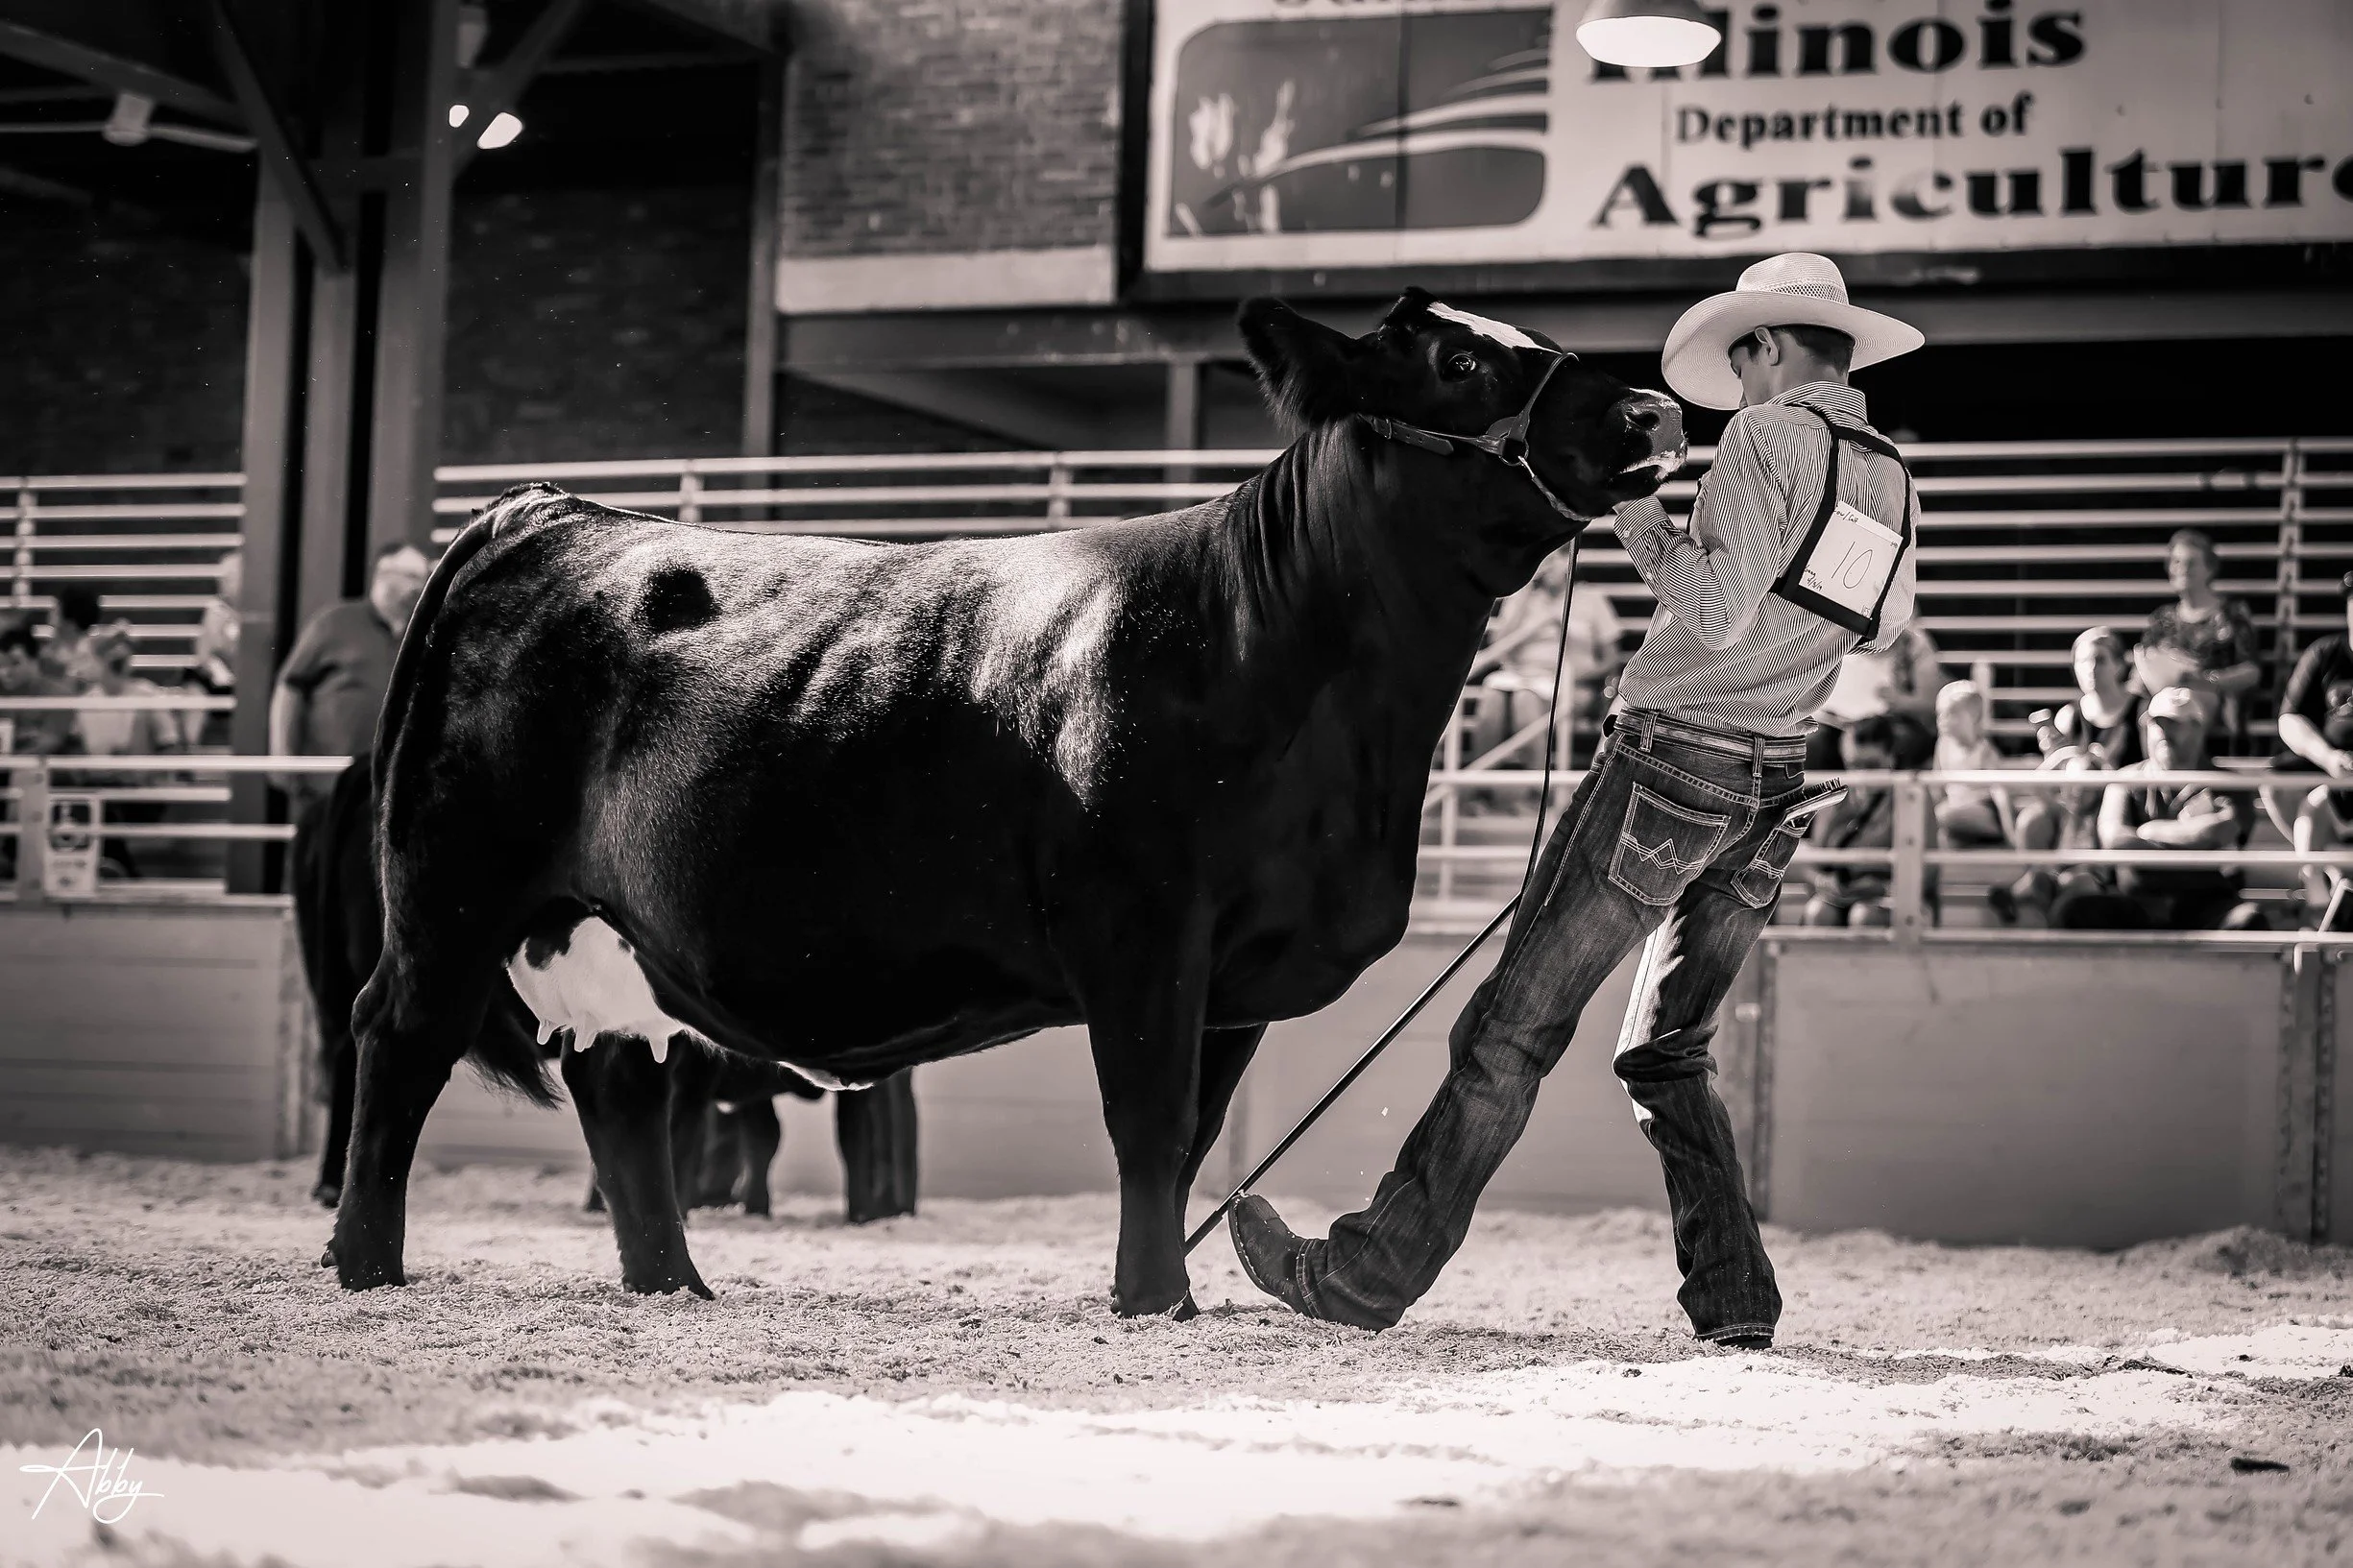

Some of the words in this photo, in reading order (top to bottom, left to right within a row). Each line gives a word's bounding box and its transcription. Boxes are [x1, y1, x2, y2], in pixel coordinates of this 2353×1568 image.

[1590, 0, 2086, 82] linois
[1676, 100, 1965, 150] Department
[1978, 91, 2035, 136] of
[1831, 541, 1873, 589] 10
